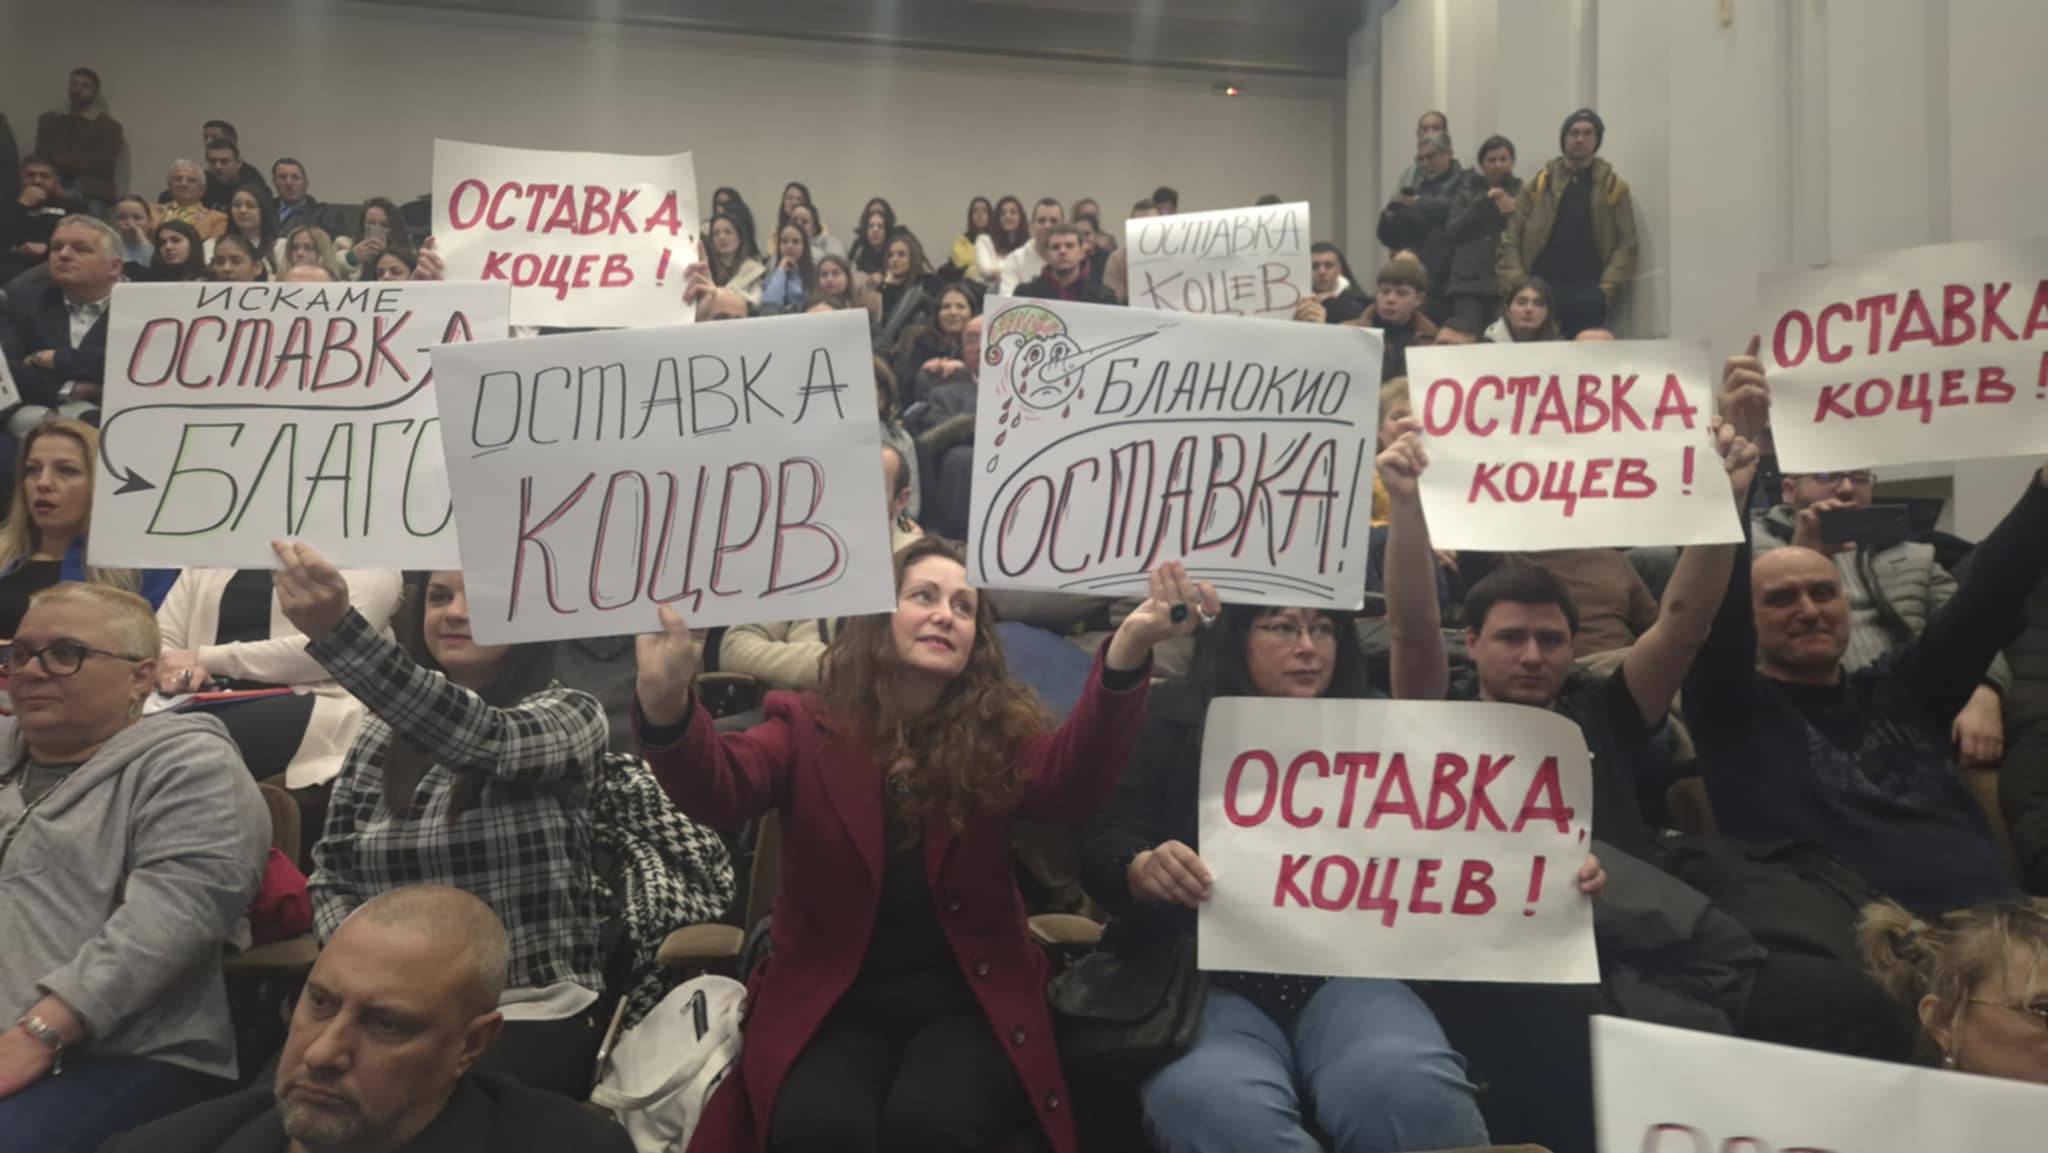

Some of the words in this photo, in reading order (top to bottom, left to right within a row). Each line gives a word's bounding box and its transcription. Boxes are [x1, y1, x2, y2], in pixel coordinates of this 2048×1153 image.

[1137, 209, 1302, 256] ОСТАВКА
[196, 286, 404, 314] ИСКАМЕ
[480, 250, 635, 301] КОЦЕВ
[1140, 262, 1300, 316] КОЦЕВ
[471, 347, 848, 448] ОСТАВКА
[1094, 358, 1351, 417] БЛАНОКИО
[1813, 365, 2017, 424] КОЦЕВ
[145, 416, 454, 538] БЛАГО
[996, 431, 1366, 578] ОСТАВКА!
[1467, 458, 1658, 517] КОЦЕВ
[506, 456, 850, 622] КОЦЕВ
[1273, 854, 1497, 928] КОЦЕВ
